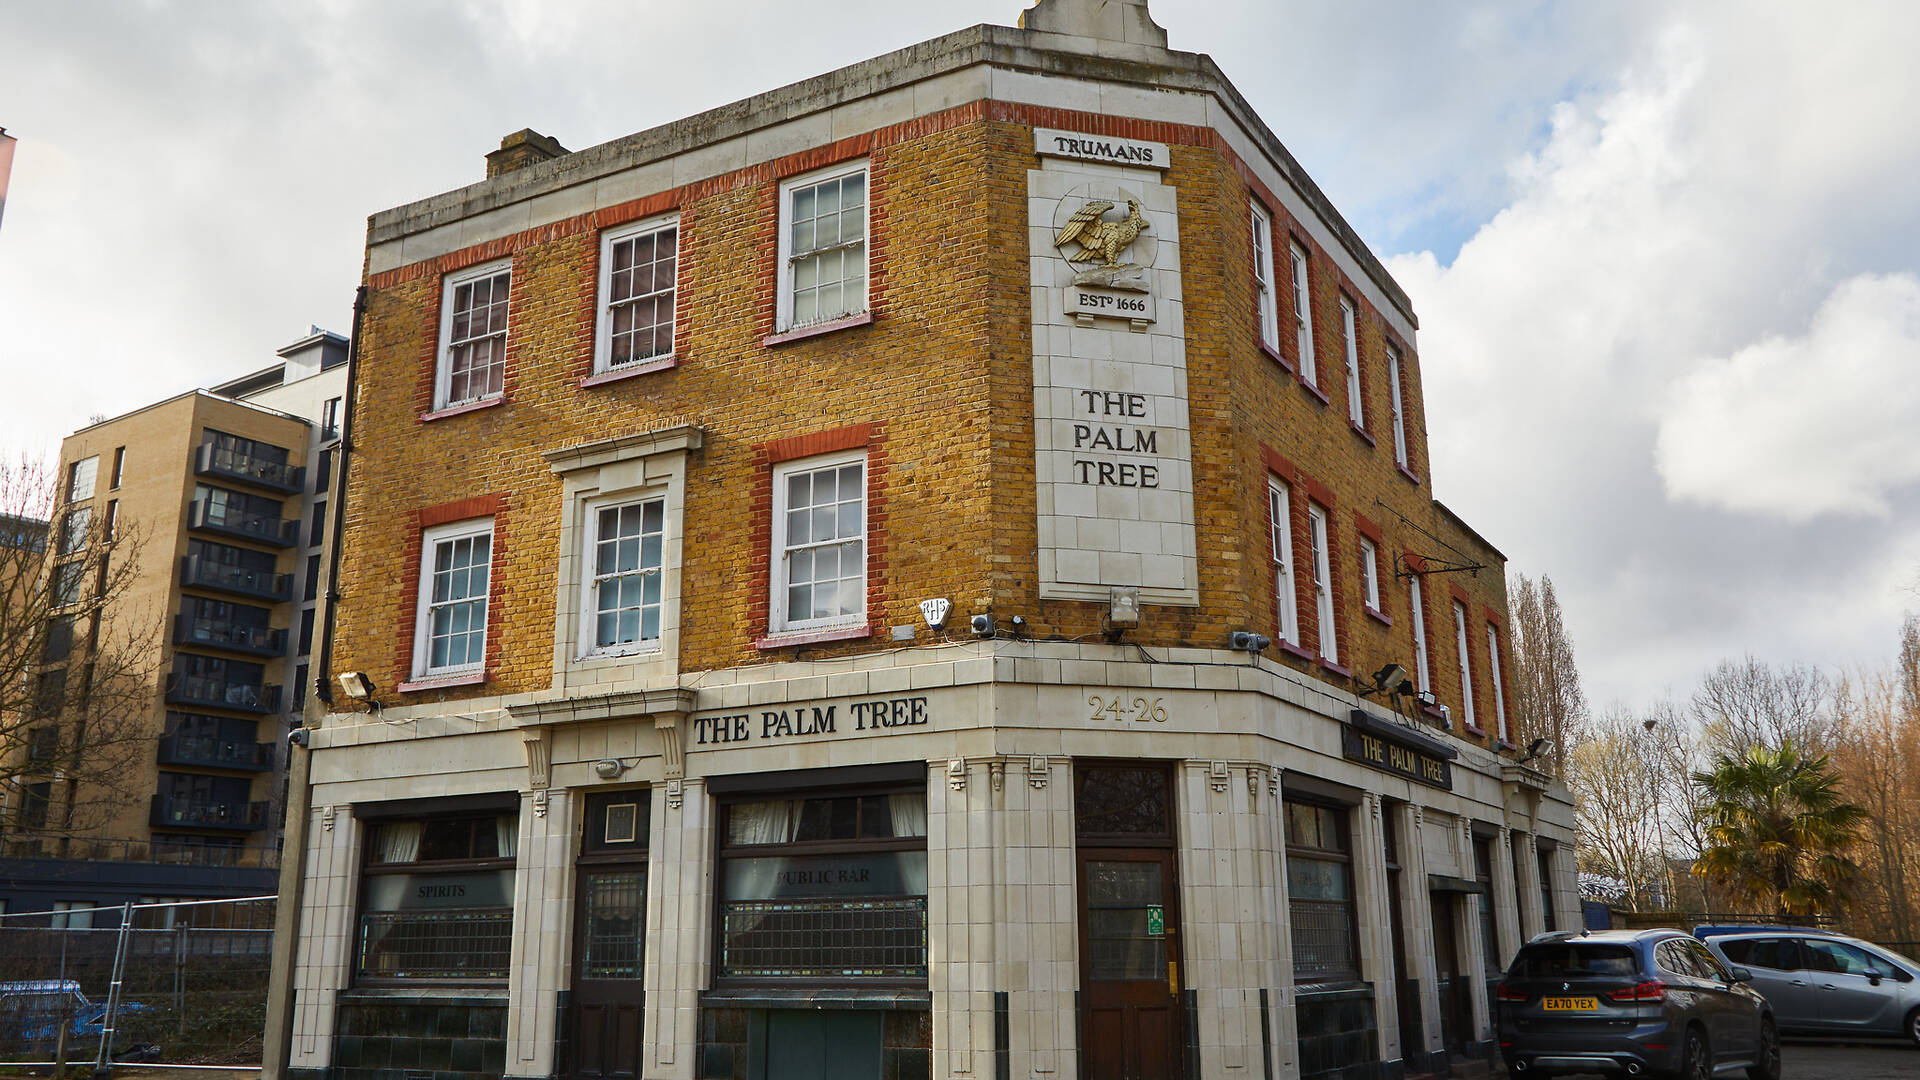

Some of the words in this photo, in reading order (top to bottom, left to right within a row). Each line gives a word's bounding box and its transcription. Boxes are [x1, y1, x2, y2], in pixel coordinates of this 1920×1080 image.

[1054, 137, 1153, 162] TRUMANS
[1117, 299, 1145, 311] 1666
[1080, 390, 1146, 417] THE
[1074, 424, 1157, 453] PALM
[1074, 460, 1159, 488] TREE
[923, 600, 945, 620] RHS
[694, 714, 749, 744] THE
[760, 705, 836, 738] PALM
[850, 696, 928, 731] TREE
[1088, 695, 1168, 722] 24-26
[1361, 734, 1384, 763] THE
[1389, 744, 1416, 774] PALM
[1420, 755, 1443, 782] TREE
[777, 870, 834, 885] PUBLIC
[838, 869, 870, 882] BAR
[418, 884, 465, 897] SPIRITS
[1546, 999, 1572, 1009] EA70
[1575, 999, 1594, 1009] YEX
